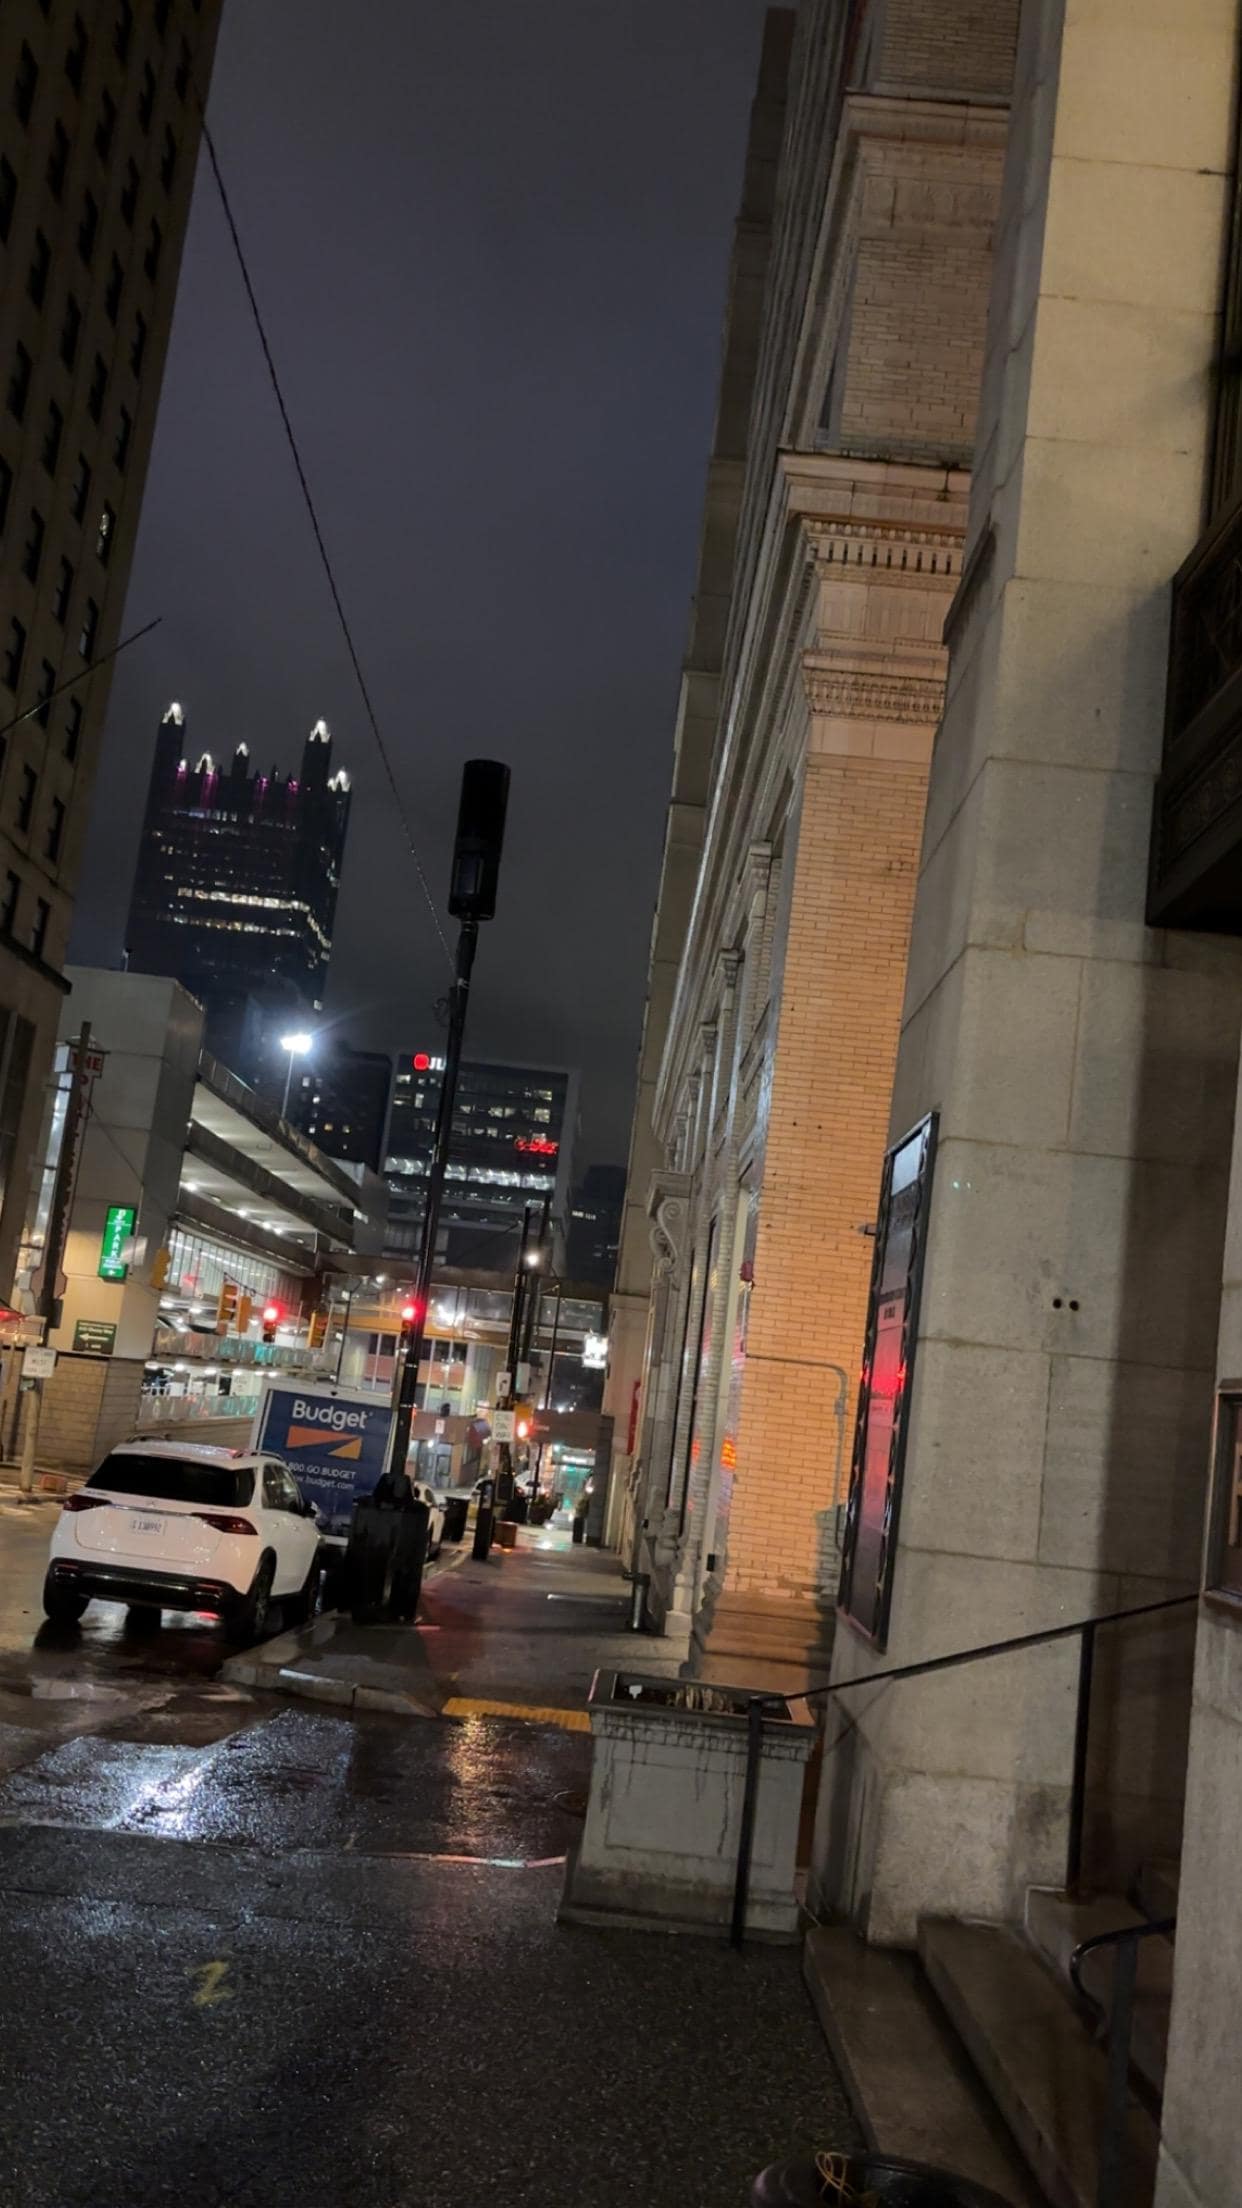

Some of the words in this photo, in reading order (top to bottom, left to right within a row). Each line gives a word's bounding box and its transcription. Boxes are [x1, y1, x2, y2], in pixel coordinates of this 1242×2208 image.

[428, 1057, 447, 1071] JL
[110, 1226, 123, 1259] PARK
[291, 1399, 368, 1431] Budget
